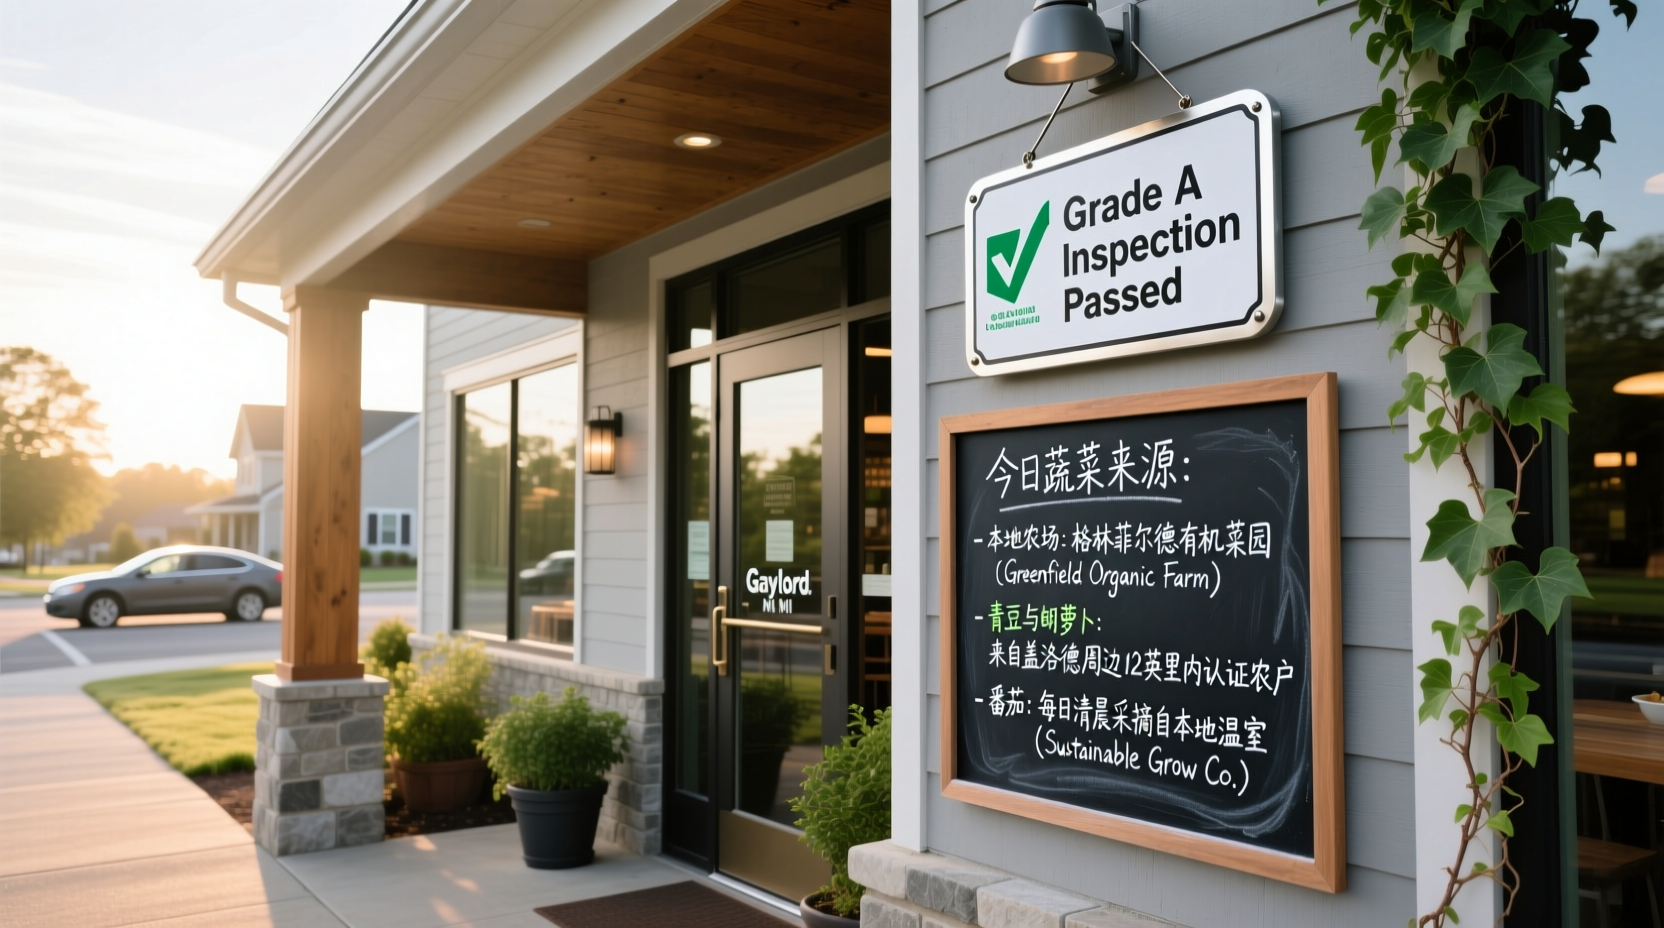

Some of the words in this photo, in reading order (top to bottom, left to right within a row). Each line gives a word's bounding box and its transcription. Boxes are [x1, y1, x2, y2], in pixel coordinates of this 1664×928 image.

[1063, 178, 1163, 231] Grade
[1174, 164, 1203, 206] A
[1063, 212, 1240, 278] Inspection
[1064, 266, 1182, 323] Passed
[986, 439, 1190, 499] 今日蔬菜来源:
[995, 558, 1083, 587] (Greenfield
[1089, 559, 1156, 599] Organic
[1163, 560, 1221, 599] Farm)
[1035, 724, 1141, 770] (Sustainable
[1148, 745, 1198, 780] Grow
[1204, 754, 1249, 797] Co.)
